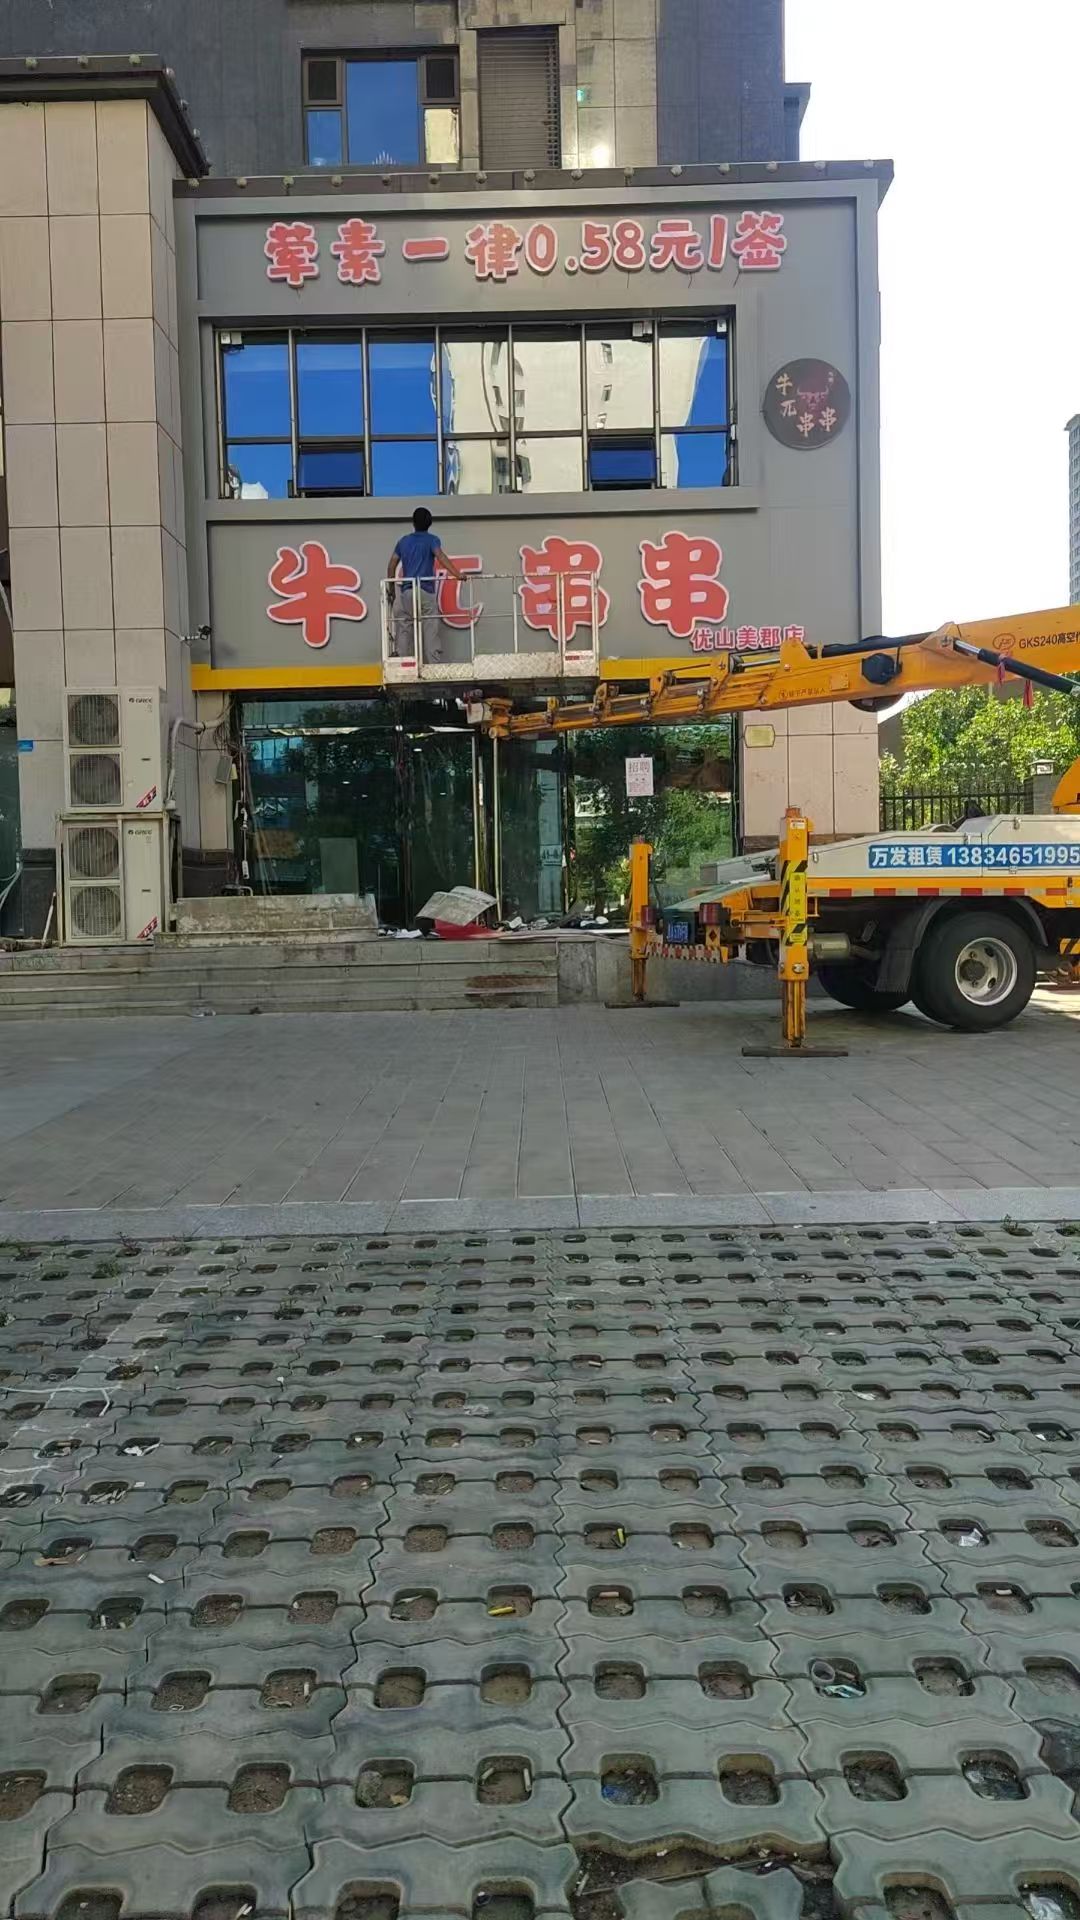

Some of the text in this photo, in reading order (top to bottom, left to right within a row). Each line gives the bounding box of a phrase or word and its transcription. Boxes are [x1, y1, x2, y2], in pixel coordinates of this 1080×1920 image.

[872, 846, 1080, 866] 万发租赁 13834651995
